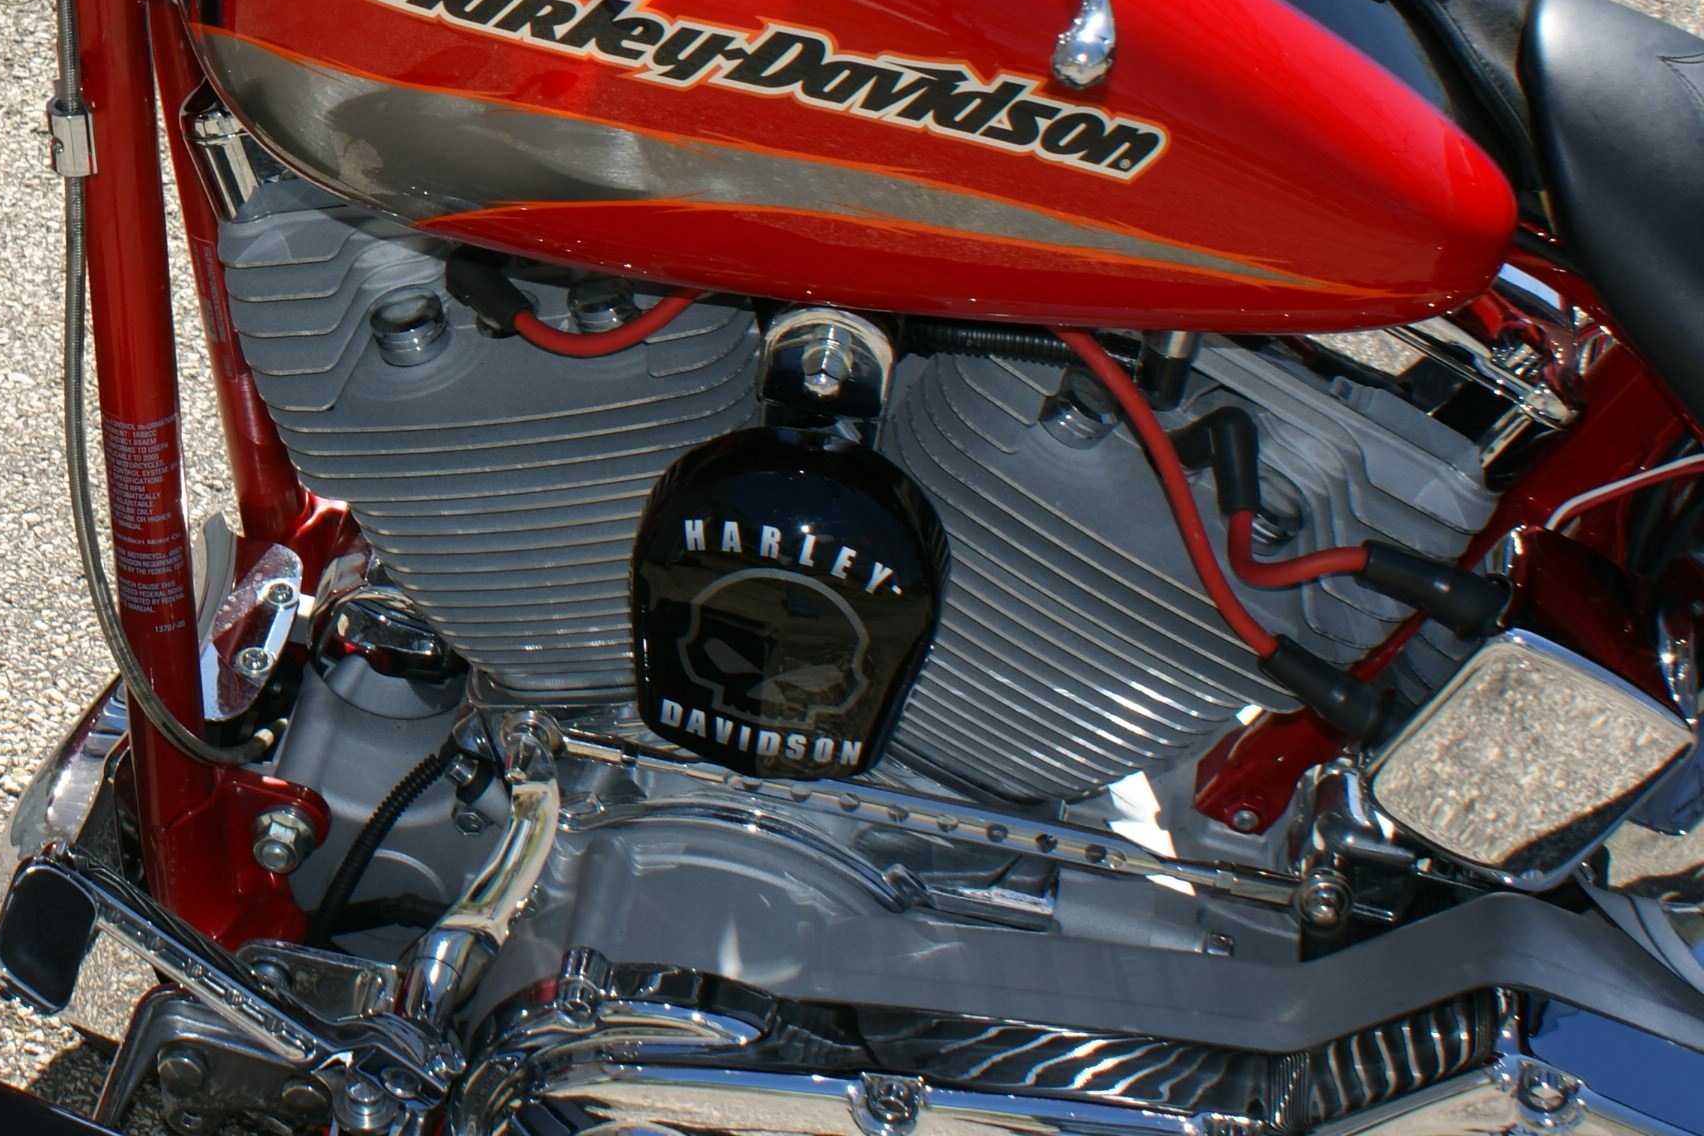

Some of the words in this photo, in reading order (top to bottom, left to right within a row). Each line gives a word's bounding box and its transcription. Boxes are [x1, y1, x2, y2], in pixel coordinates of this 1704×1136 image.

[138, 445, 147, 454] TO
[130, 484, 145, 493] RPM
[659, 698, 864, 767] DAVIDSON
